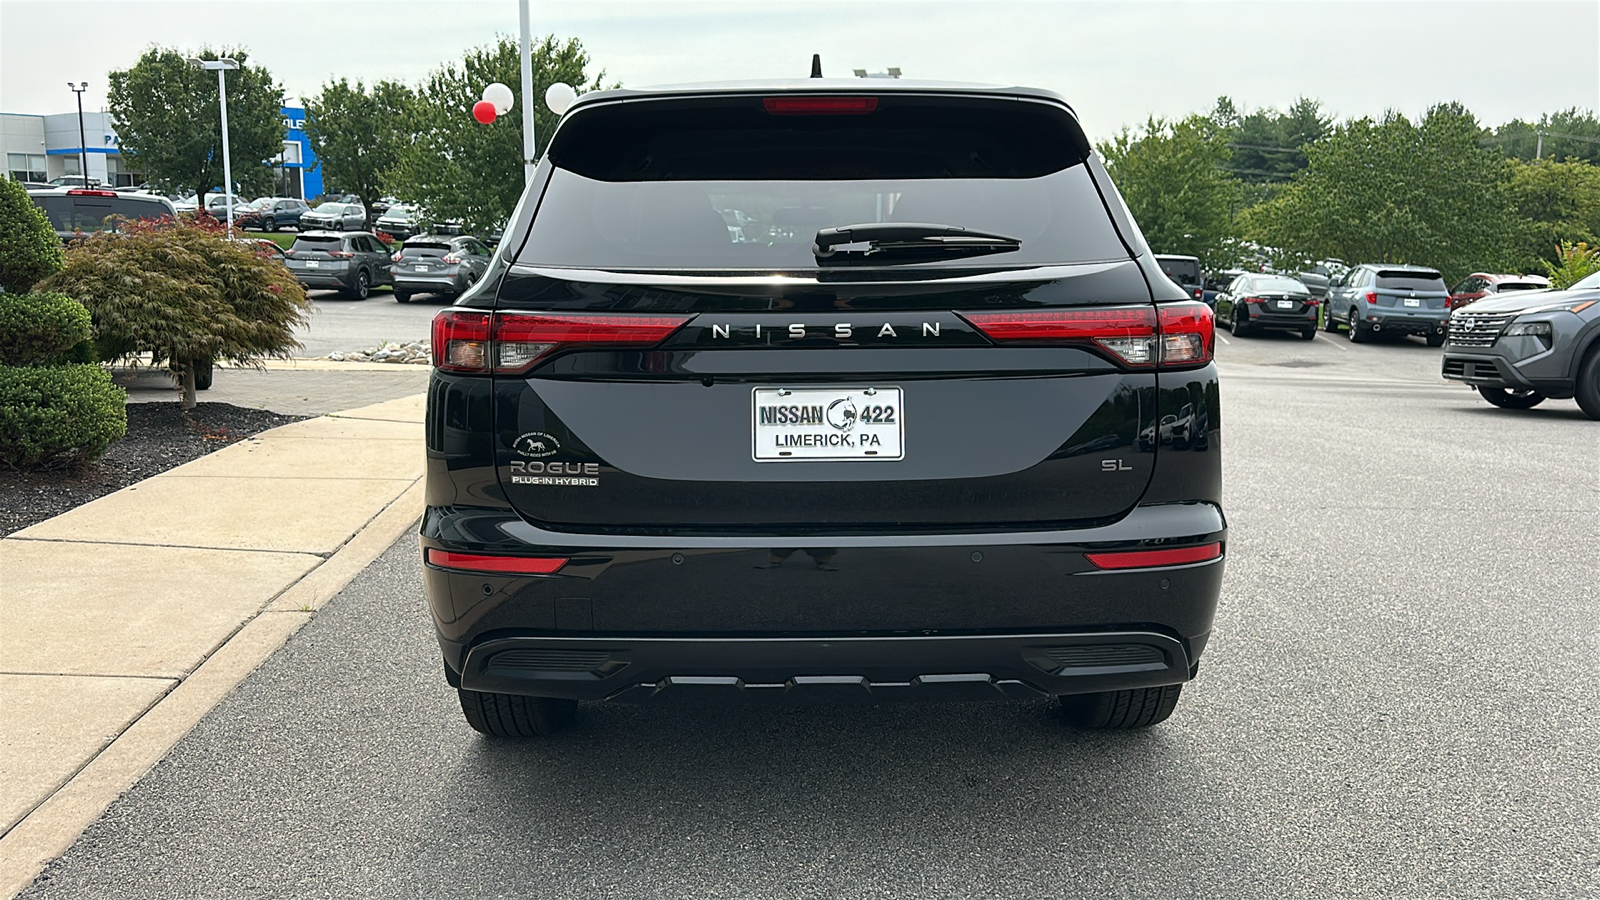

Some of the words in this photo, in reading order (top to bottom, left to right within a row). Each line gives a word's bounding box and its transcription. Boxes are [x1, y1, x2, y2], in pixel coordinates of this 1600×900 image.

[712, 322, 940, 338] NISSAN
[759, 405, 824, 425] NISSAN
[860, 405, 896, 424] 422
[775, 433, 855, 448] LIMERICK,
[860, 433, 881, 446] PA
[510, 460, 599, 475] ROGUE
[1101, 459, 1133, 471] SL
[512, 476, 553, 484] PLUG-IN
[555, 477, 598, 486] HYBRID
